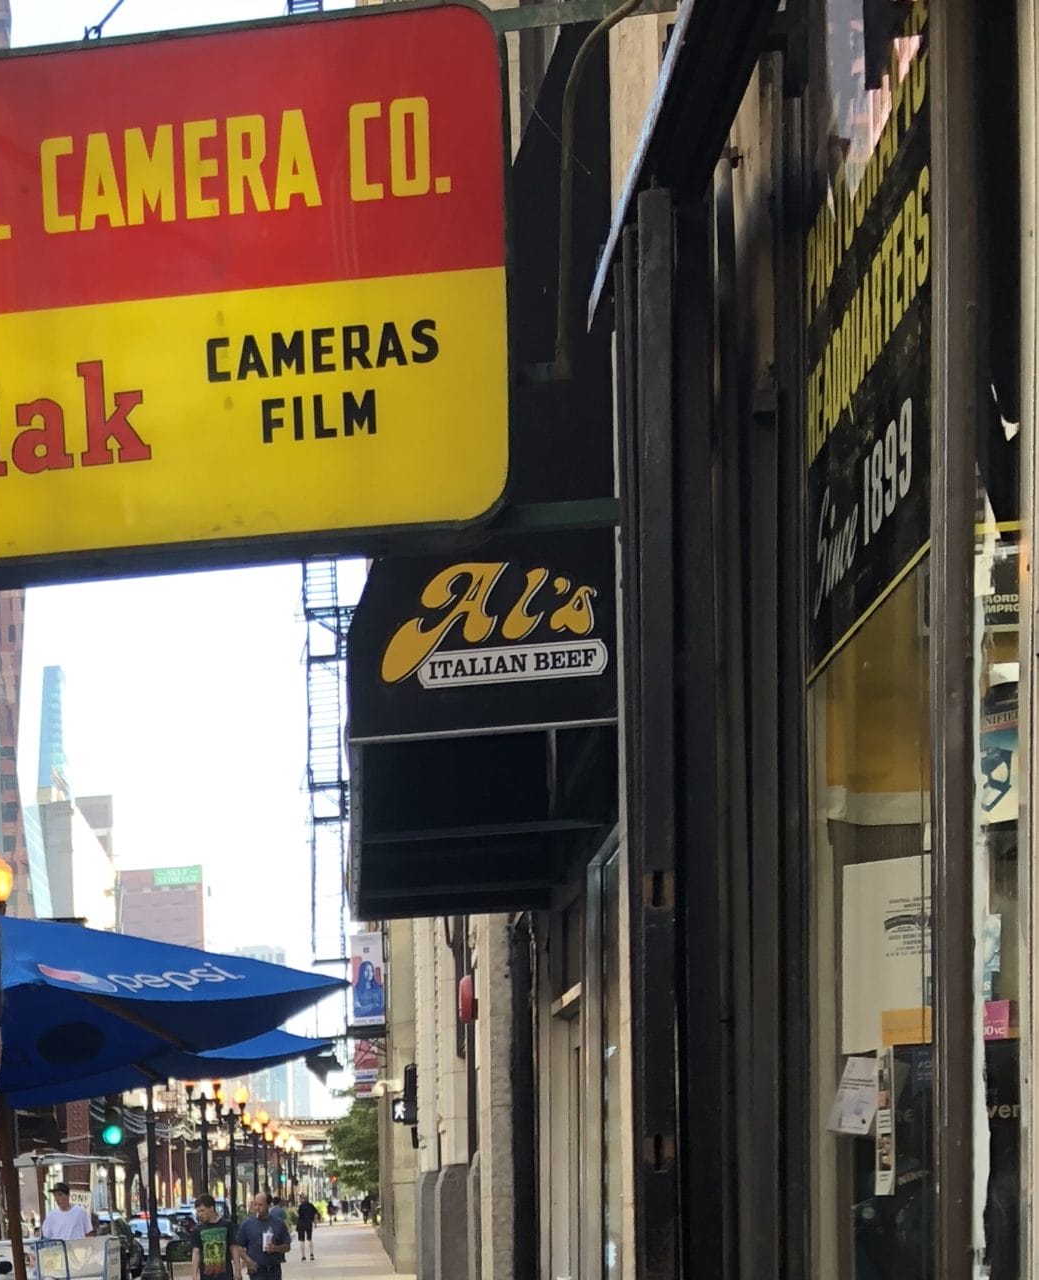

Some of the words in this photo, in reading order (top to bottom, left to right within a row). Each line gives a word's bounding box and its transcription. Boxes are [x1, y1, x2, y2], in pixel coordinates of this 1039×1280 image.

[40, 108, 322, 235] CAMERA
[348, 95, 452, 202] CO.
[206, 318, 440, 383] CAMERAS
[807, 165, 930, 468] HEADQUARTERS
[260, 389, 378, 444] FILM
[814, 485, 859, 620] Since
[864, 397, 912, 546] 1899
[382, 562, 597, 682] Al's
[429, 653, 527, 680] ITALIAN
[534, 648, 597, 671] BEEF
[107, 962, 239, 993] pepsi
